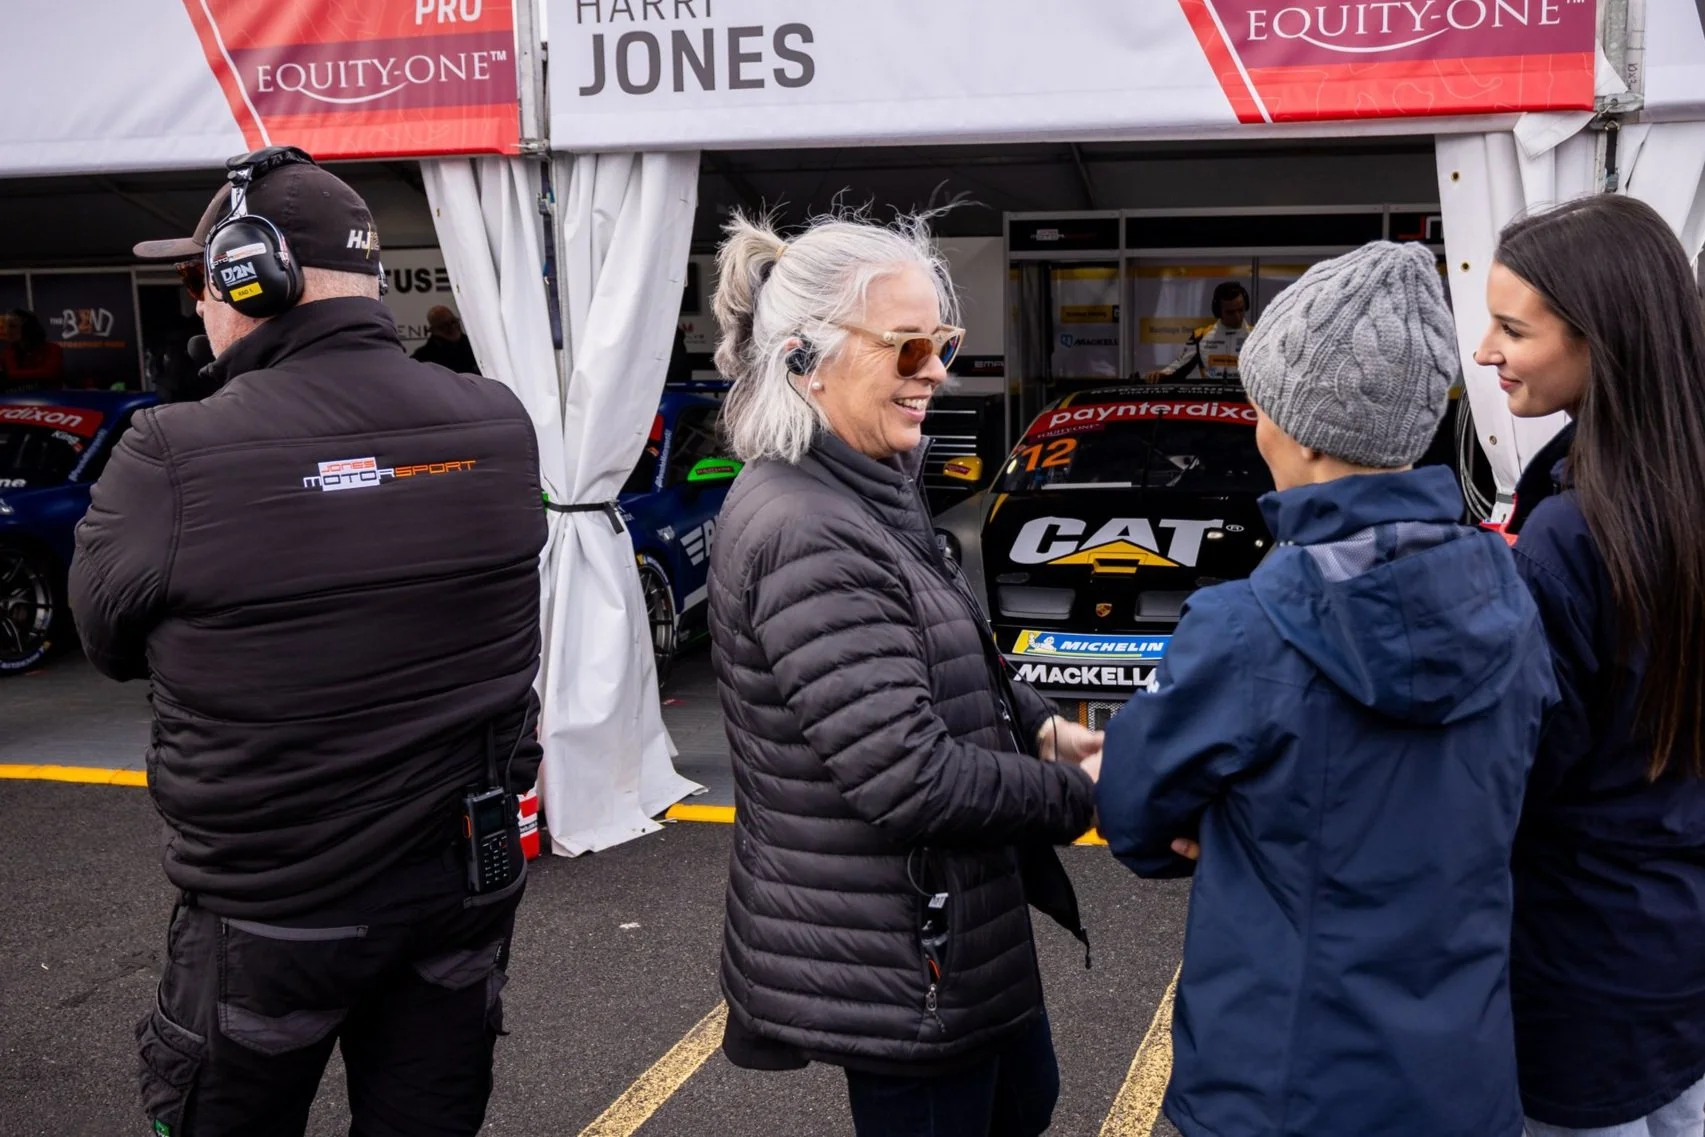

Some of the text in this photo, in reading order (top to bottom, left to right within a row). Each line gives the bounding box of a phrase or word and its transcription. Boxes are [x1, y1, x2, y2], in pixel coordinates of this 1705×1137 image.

[415, 0, 483, 25] PRO
[578, 23, 815, 96] JONES
[1020, 437, 1078, 473] 12
[303, 459, 477, 488] MOTORSPORT
[1060, 641, 1164, 652] MICHELIN
